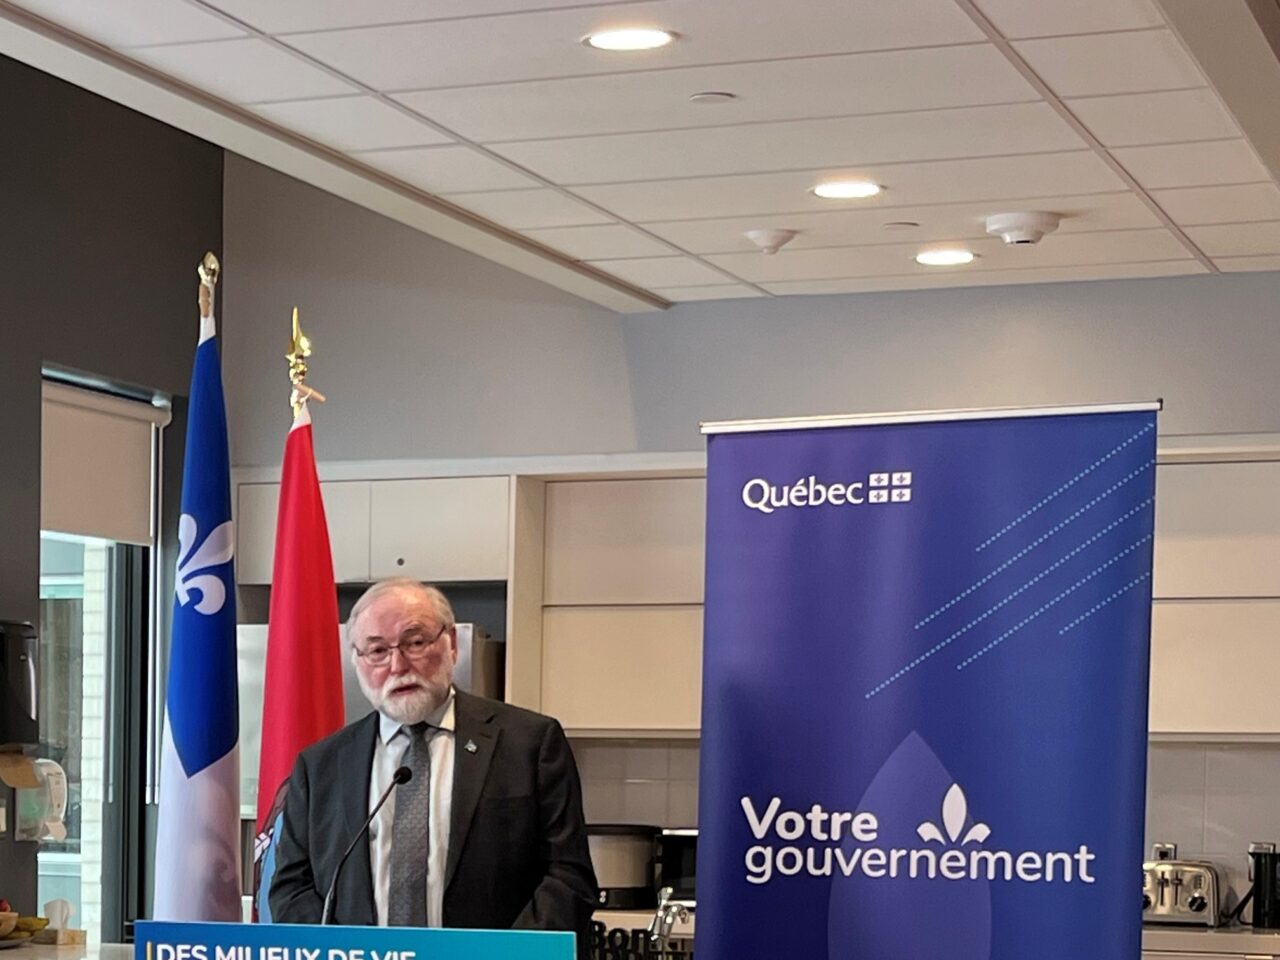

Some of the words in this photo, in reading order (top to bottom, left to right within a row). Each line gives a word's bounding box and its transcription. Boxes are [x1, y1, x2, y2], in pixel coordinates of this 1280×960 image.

[741, 474, 866, 514] Québec
[740, 796, 879, 842] Votre
[744, 844, 1097, 884] gouvernement
